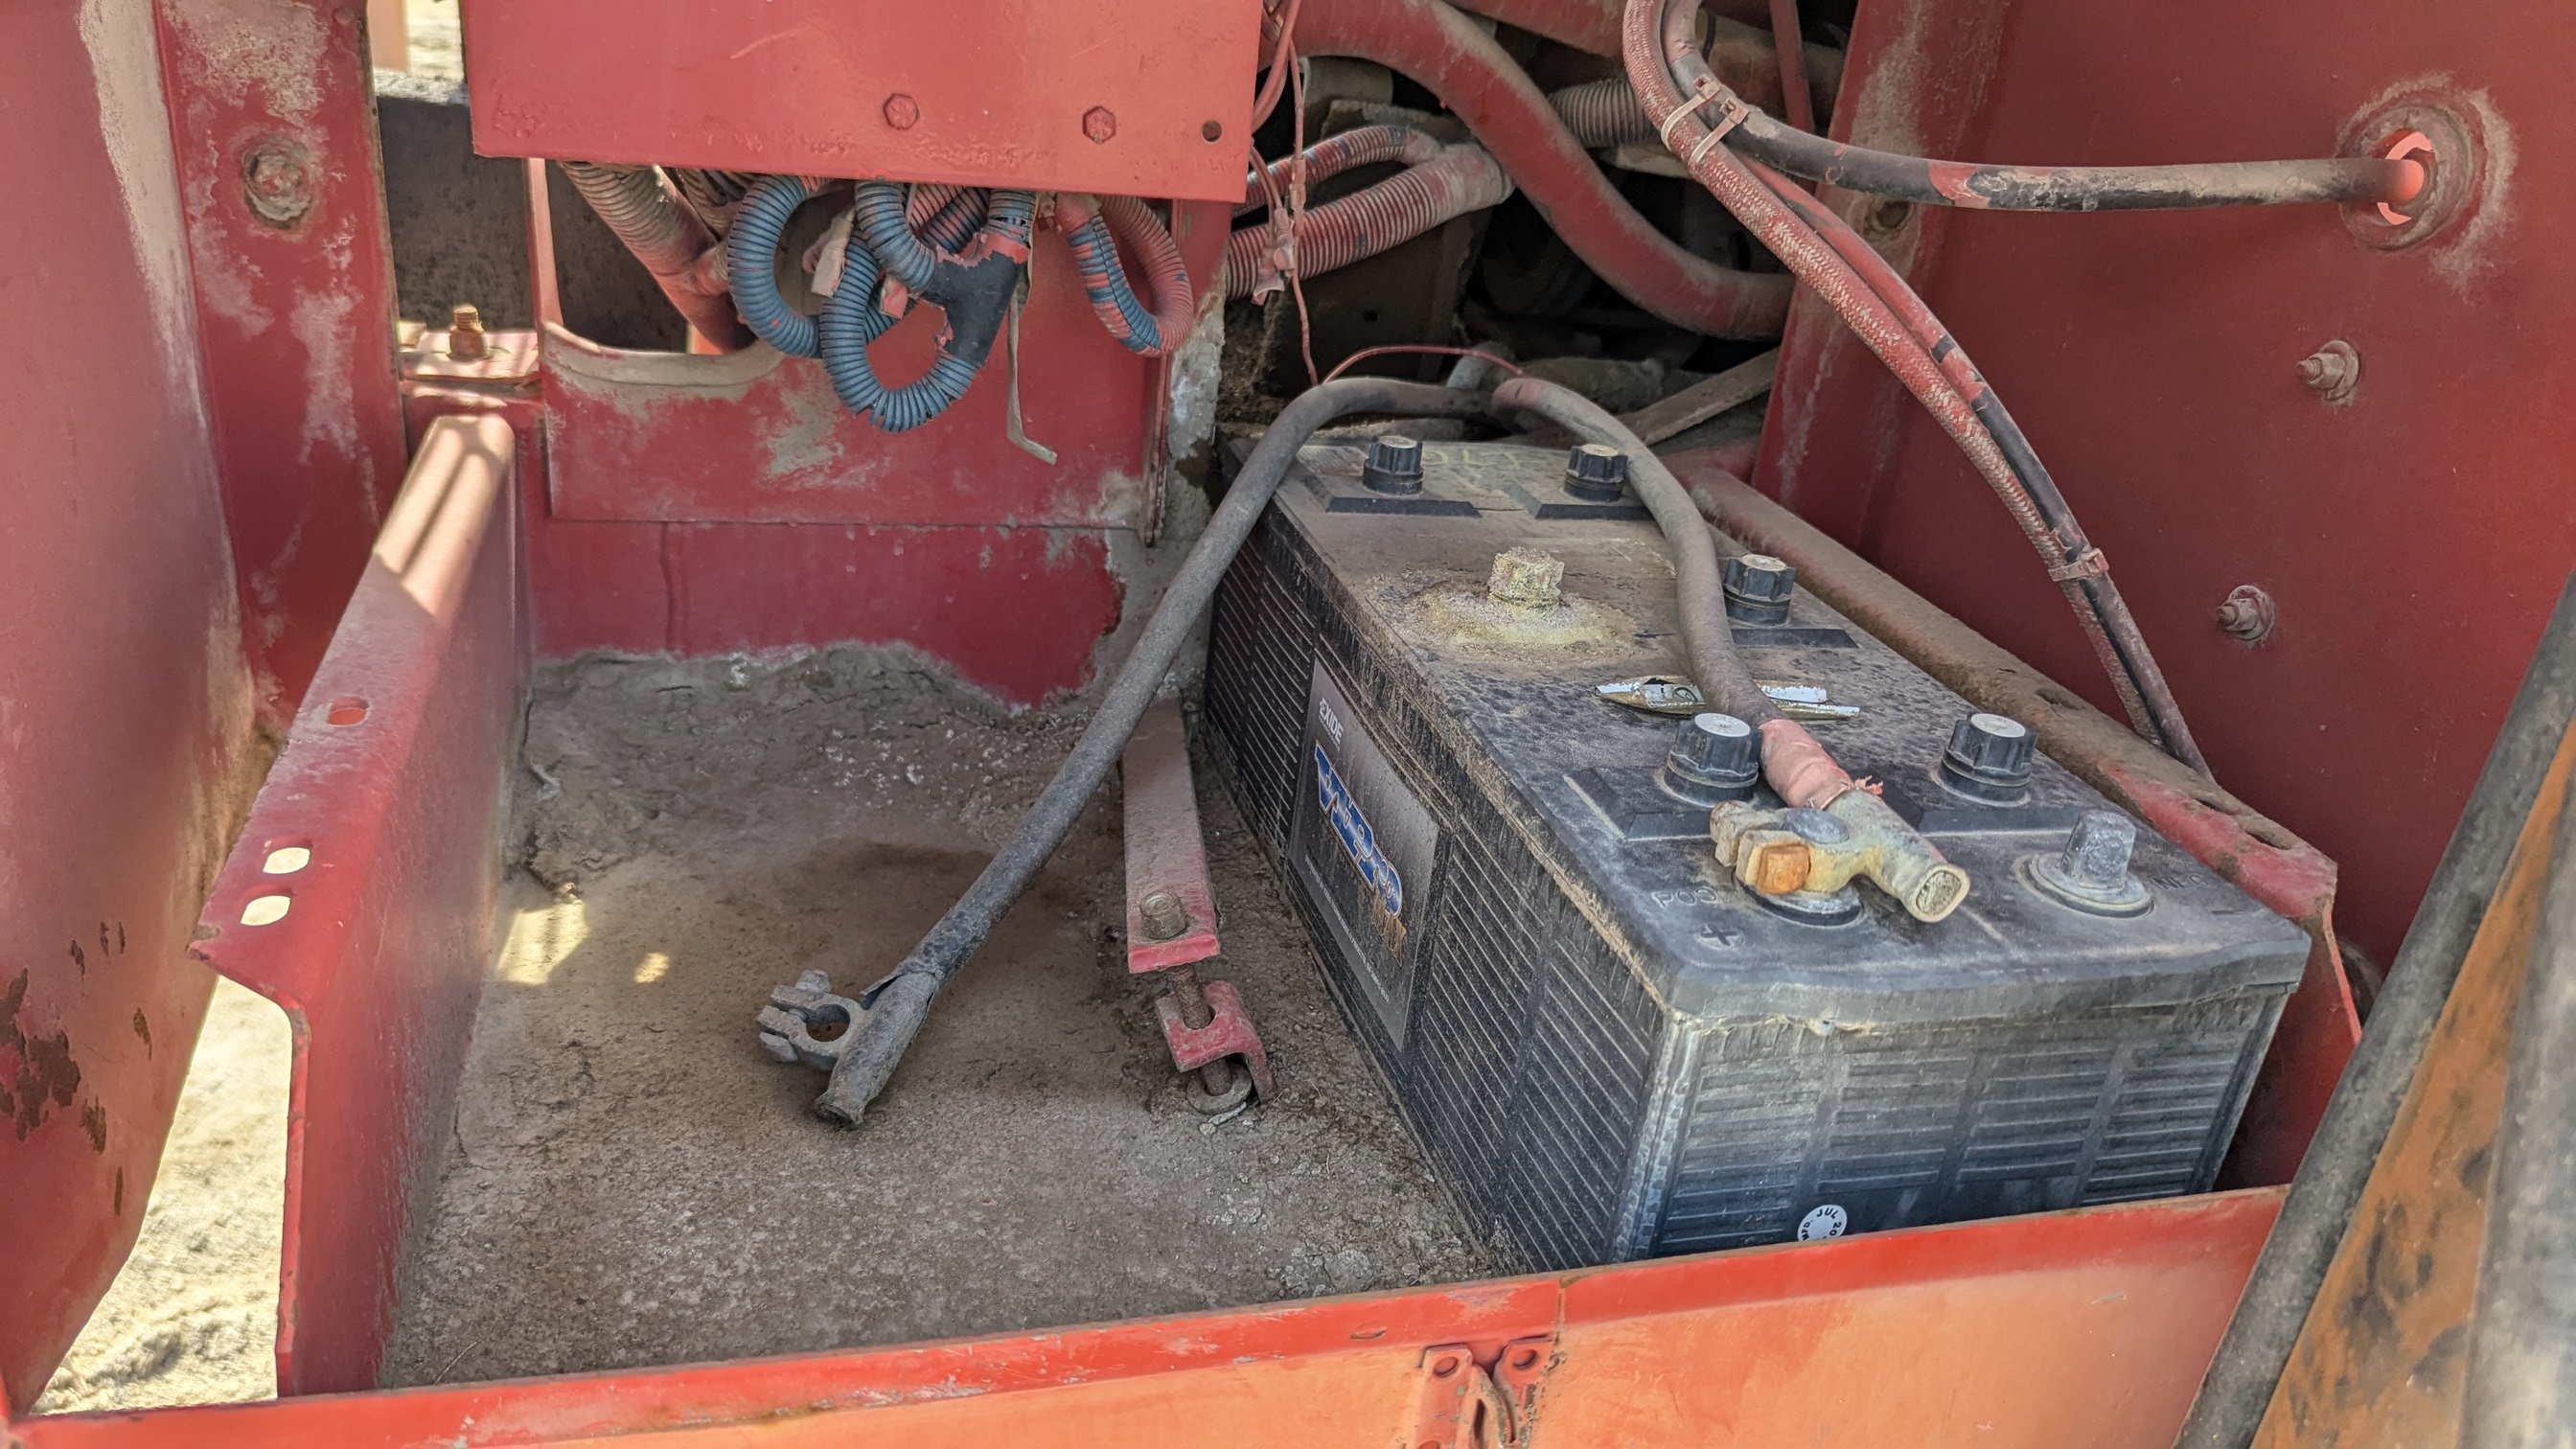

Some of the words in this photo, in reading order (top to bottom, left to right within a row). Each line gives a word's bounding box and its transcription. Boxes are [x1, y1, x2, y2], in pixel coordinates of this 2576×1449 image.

[1319, 697, 1345, 745] EXIDE
[1651, 886, 1718, 908] POS
[1816, 1207, 1839, 1220] JUL
